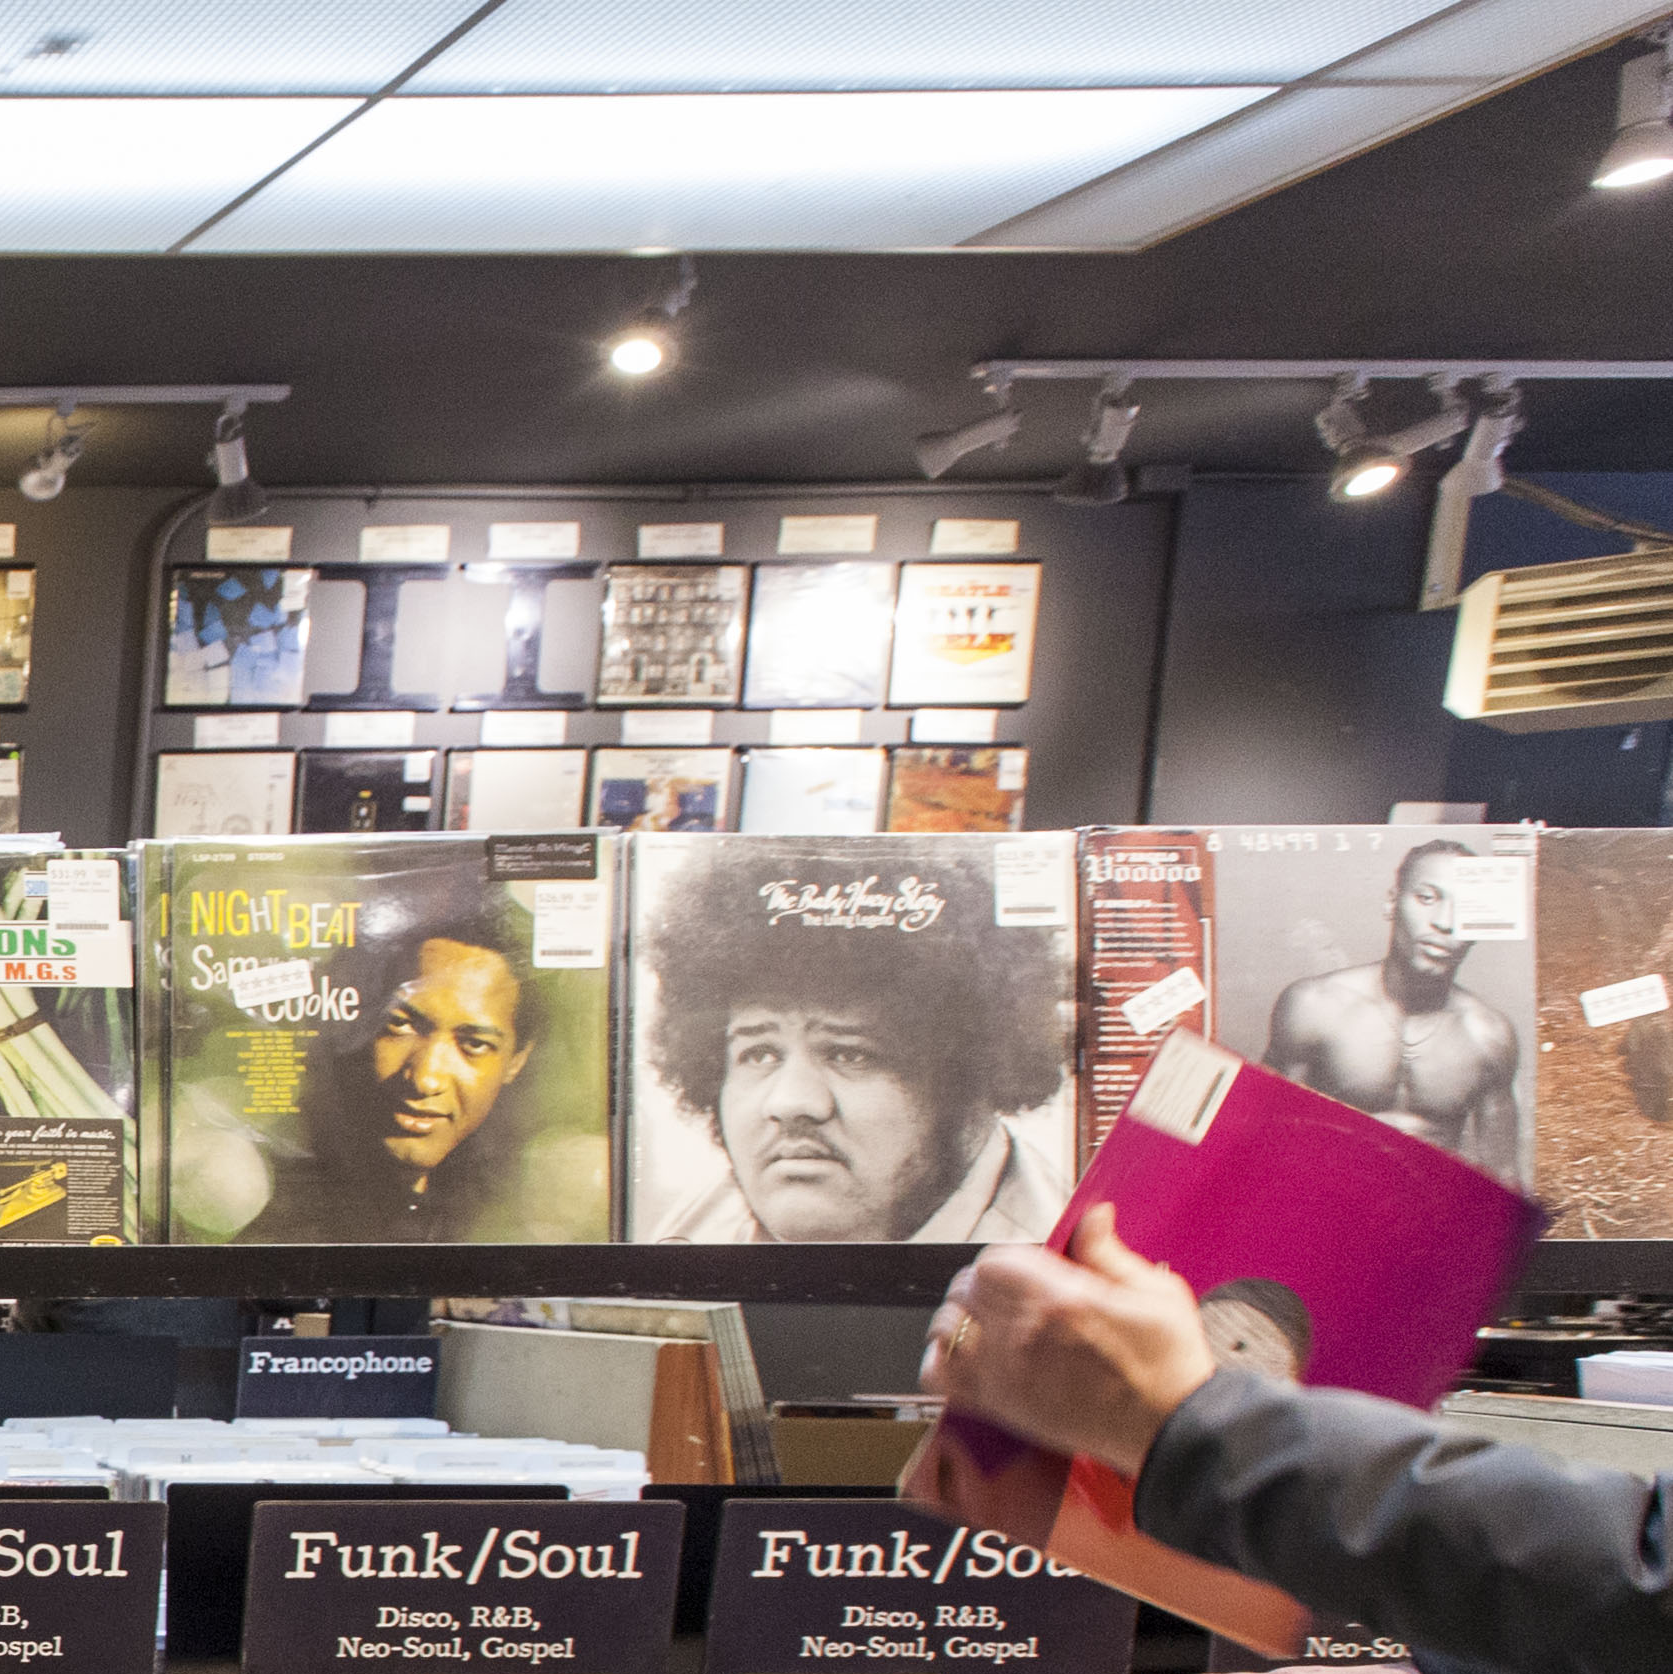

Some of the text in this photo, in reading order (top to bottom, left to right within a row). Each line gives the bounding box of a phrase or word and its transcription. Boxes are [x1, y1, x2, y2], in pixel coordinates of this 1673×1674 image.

[191, 889, 361, 948] NIGHT BEAT
[247, 1351, 433, 1379] Francophone
[284, 1527, 643, 1585] Funk/Soul
[377, 1606, 541, 1631] Disco, R&B,
[842, 1605, 1007, 1631] Disco, R&B,
[336, 1636, 575, 1664] Neo-Soul, Gospel
[800, 1635, 1039, 1663] Neo-Soul, Gospel
